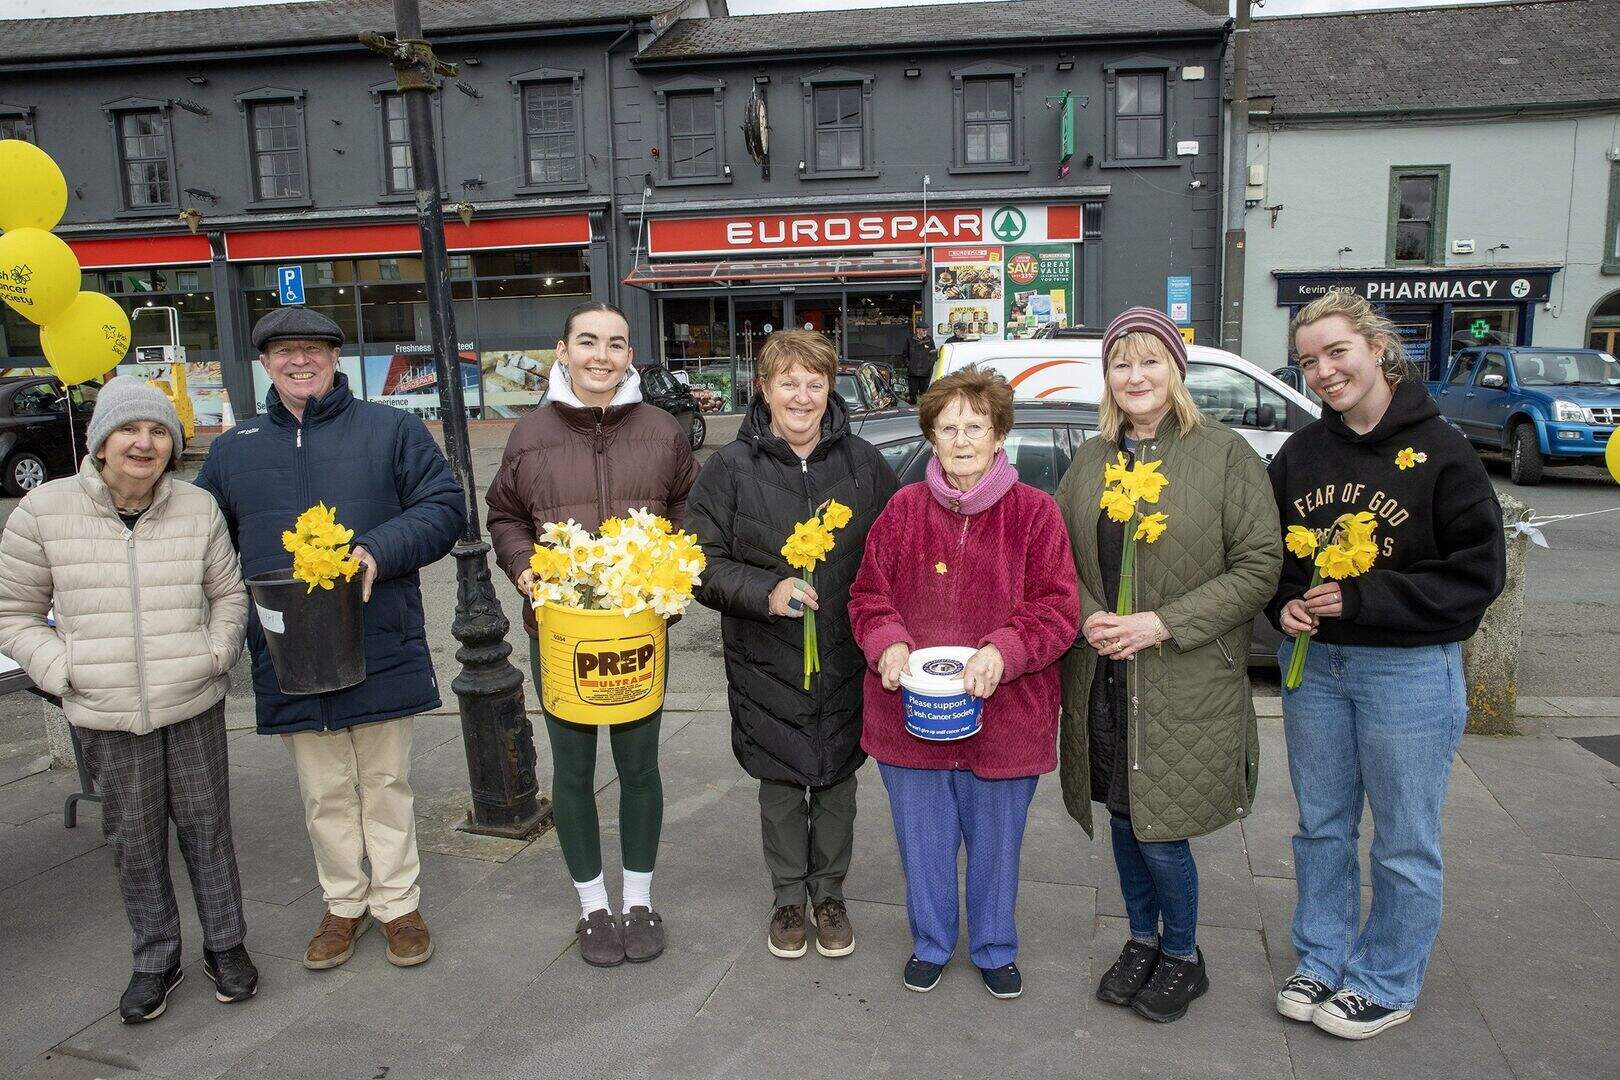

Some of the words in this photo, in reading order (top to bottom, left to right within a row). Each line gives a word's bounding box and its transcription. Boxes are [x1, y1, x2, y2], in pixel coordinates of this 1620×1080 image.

[726, 214, 981, 244] EUROSPAR
[1007, 262, 1038, 273] SAVE
[285, 270, 295, 285] P
[1298, 285, 1326, 294] Kevin
[1366, 280, 1498, 300] PHARMACY
[395, 344, 432, 353] Freshness
[1293, 484, 1335, 518] FEAR
[1341, 482, 1365, 504] OF
[1368, 490, 1410, 527] GOD
[576, 643, 654, 679] PREP
[599, 676, 638, 688] ULTRA
[909, 696, 931, 708] Please
[933, 698, 966, 710] support
[913, 709, 927, 719] Irish
[927, 713, 951, 721] Cancer
[952, 708, 975, 719] Society
